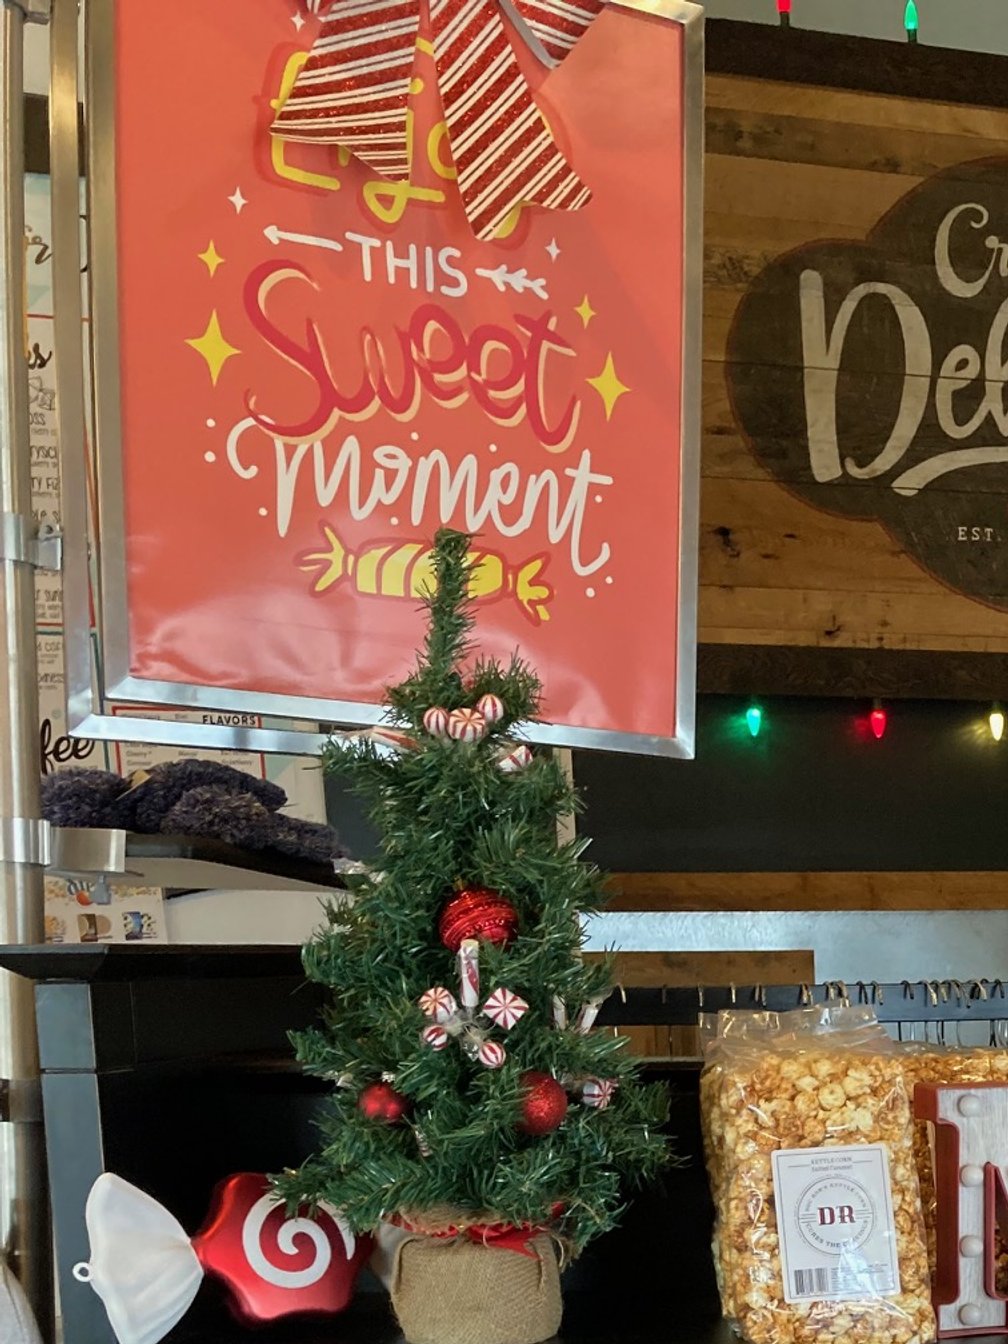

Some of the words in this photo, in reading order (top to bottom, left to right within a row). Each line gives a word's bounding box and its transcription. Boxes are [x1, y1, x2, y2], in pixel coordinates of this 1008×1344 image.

[346, 232, 468, 297] THIS
[243, 259, 581, 453] Sweet
[227, 417, 613, 577] Moment
[202, 714, 256, 726] FLAVORS
[818, 1205, 856, 1226] DR
